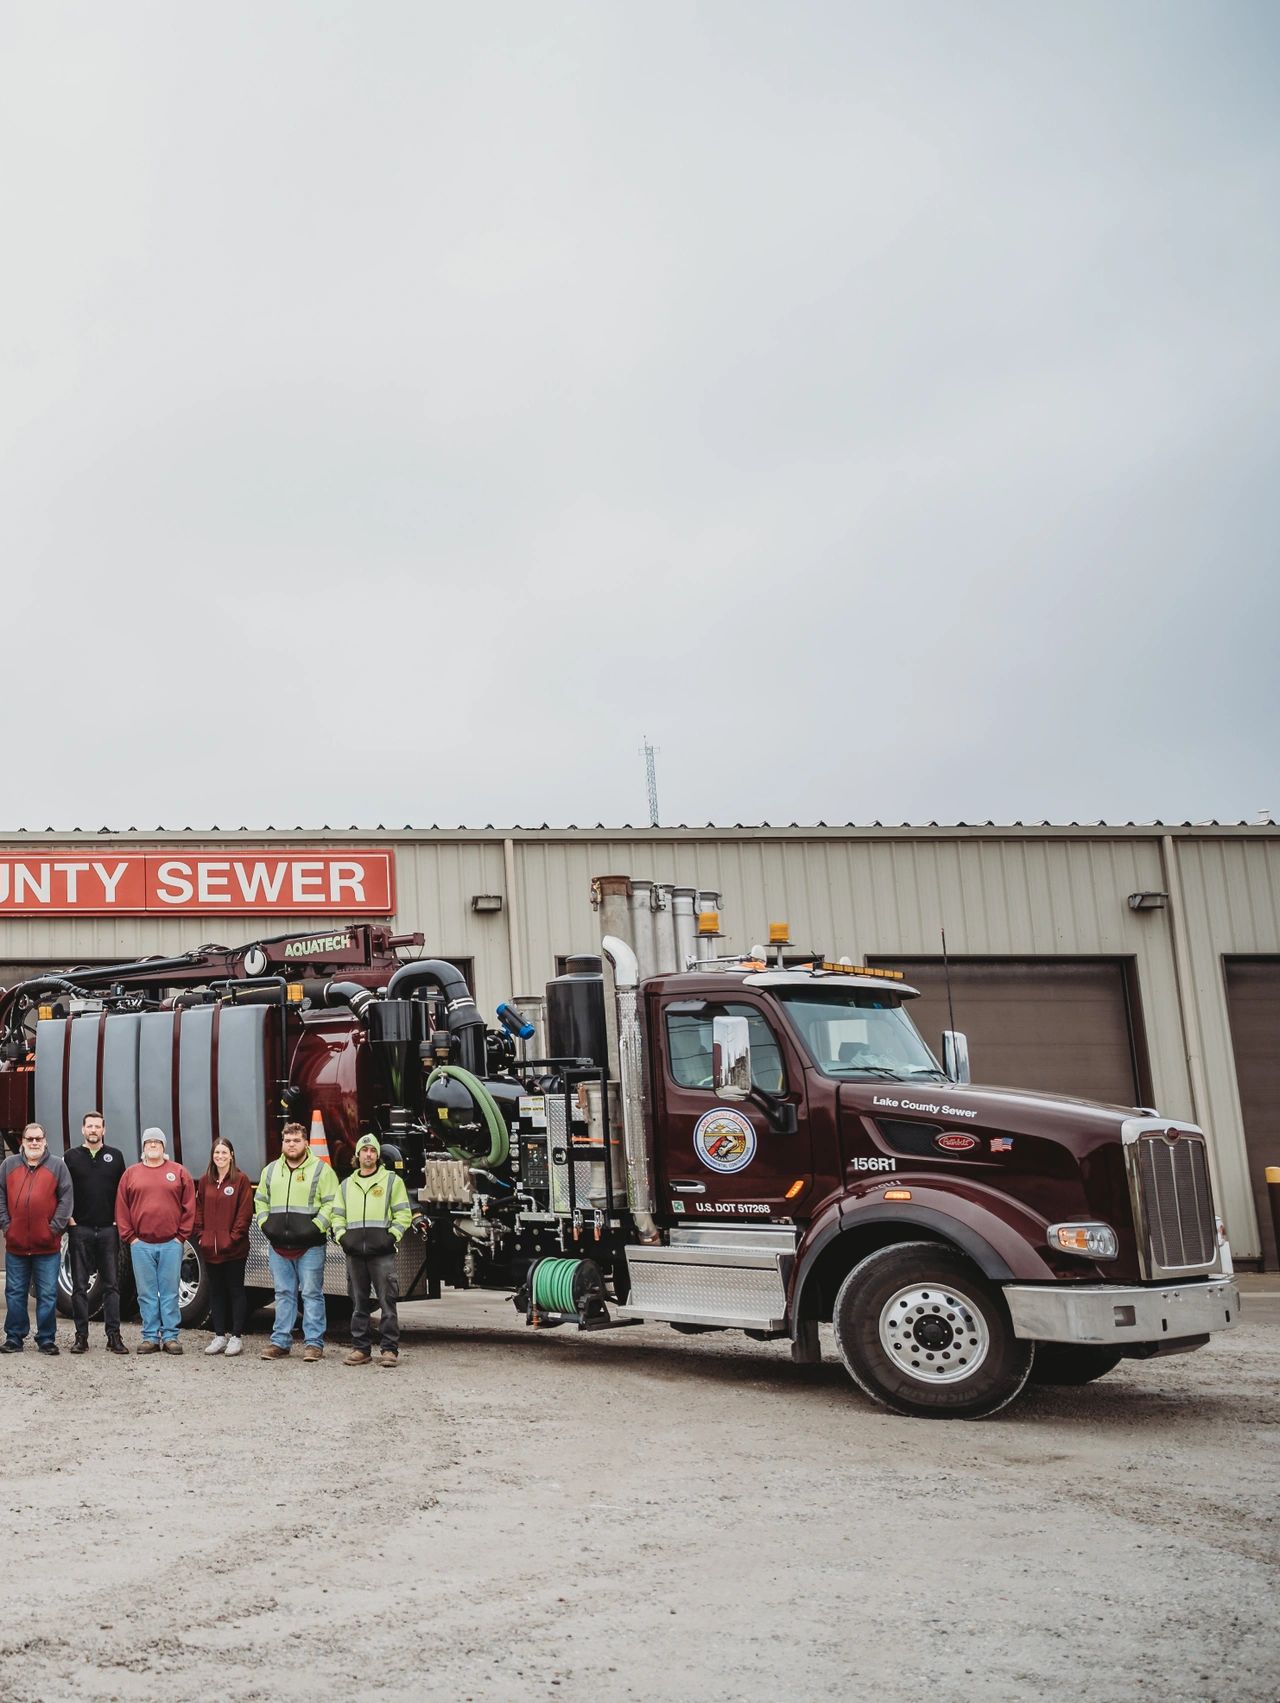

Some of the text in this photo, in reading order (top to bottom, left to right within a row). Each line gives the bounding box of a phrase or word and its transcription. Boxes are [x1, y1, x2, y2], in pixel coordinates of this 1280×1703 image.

[156, 861, 367, 904] SEWER
[284, 934, 352, 957] AQUATECH
[873, 1096, 977, 1118] Lake County Sewer
[851, 1157, 897, 1171] 156R1
[695, 1203, 771, 1214] U.S. DOT 517268
